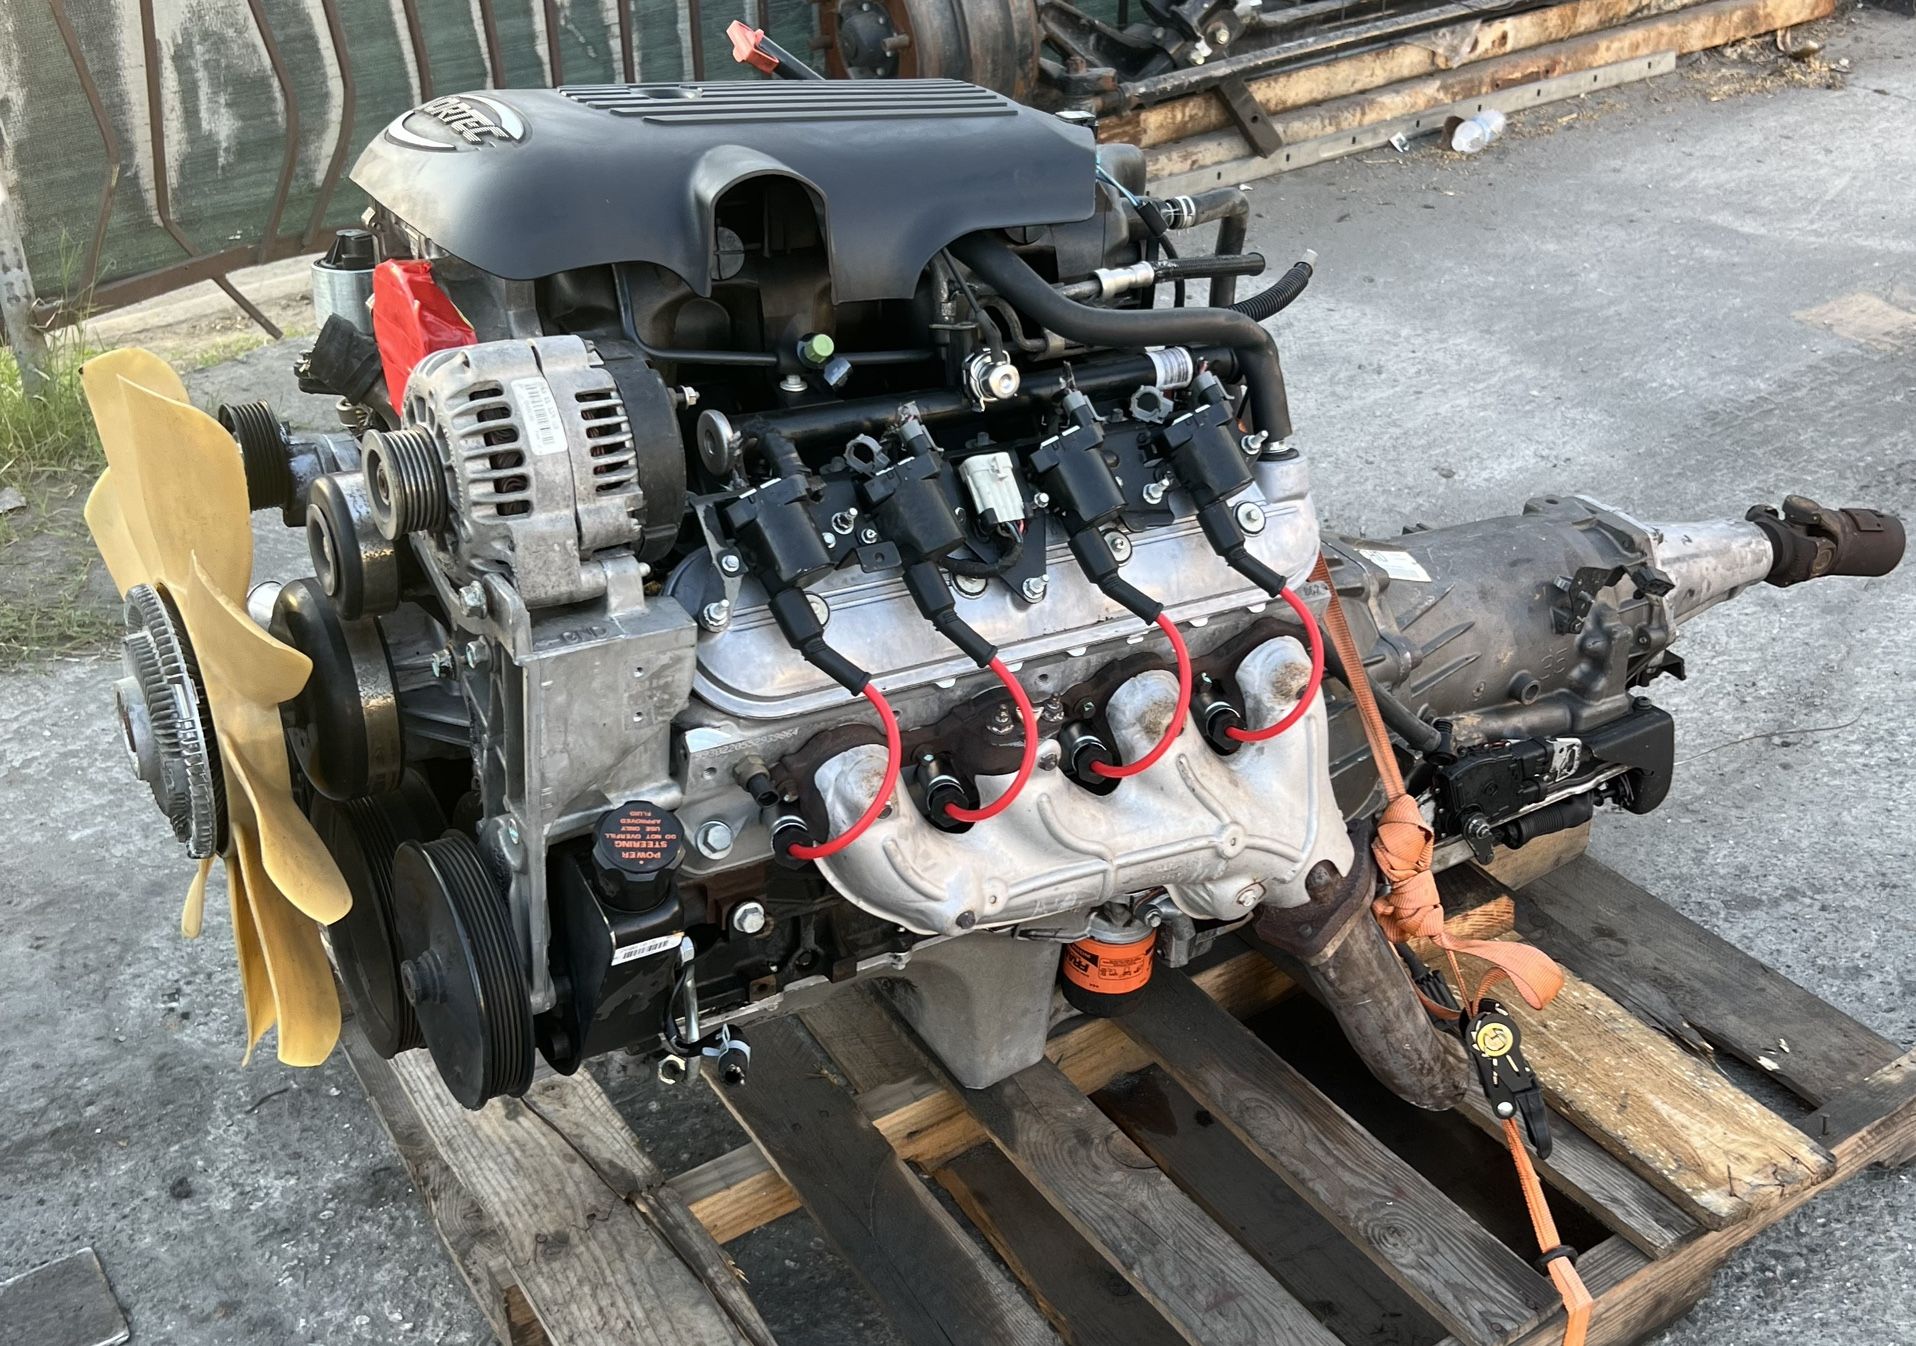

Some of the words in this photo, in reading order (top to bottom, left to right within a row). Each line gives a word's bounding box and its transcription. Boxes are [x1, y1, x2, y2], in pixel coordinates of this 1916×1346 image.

[418, 96, 510, 145] ORTEC
[604, 832, 642, 840] OVERFILL
[614, 840, 668, 848] STEERING
[621, 851, 662, 859] POWER
